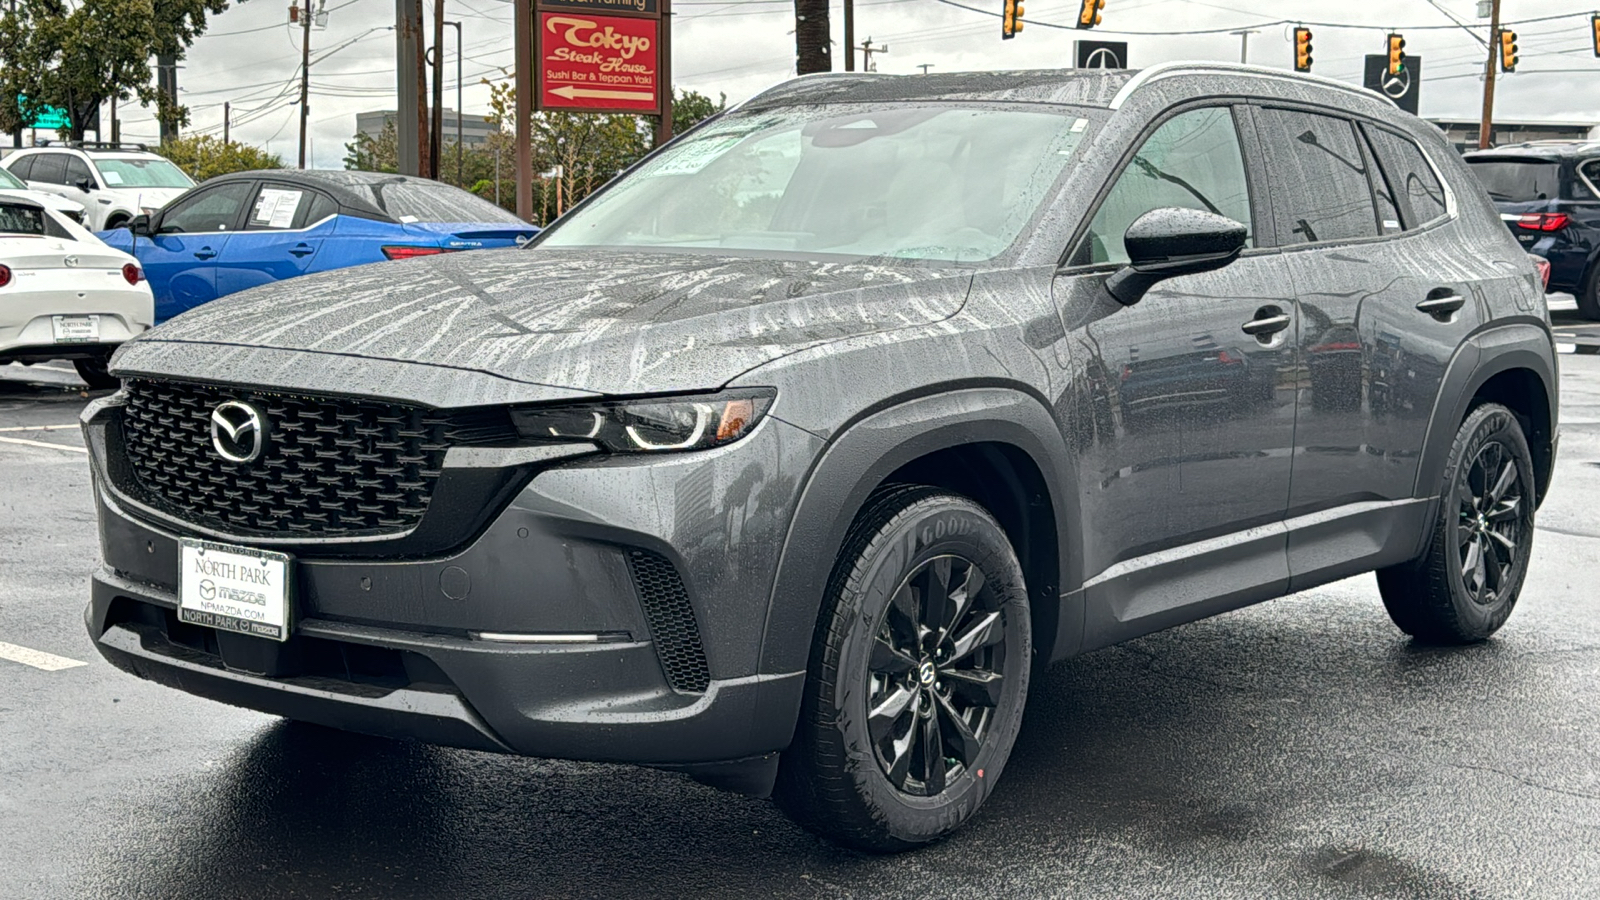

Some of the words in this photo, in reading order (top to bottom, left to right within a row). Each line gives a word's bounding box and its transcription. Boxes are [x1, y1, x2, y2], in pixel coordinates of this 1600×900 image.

[546, 16, 651, 59] Tokyo
[546, 47, 604, 64] Steak
[599, 57, 654, 75] House
[546, 70, 570, 80] Sushi
[572, 71, 587, 81] Bar
[589, 72, 597, 81] &
[598, 72, 633, 84] Teppan
[634, 75, 652, 84] Yaki
[203, 543, 220, 551] SAN
[222, 546, 260, 557] ANTONIO
[195, 557, 236, 580] NORTH
[240, 565, 271, 586] PARK
[183, 609, 213, 625] NORTH
[215, 616, 238, 630] PARK
[200, 601, 265, 621] NPMAZDA.COM
